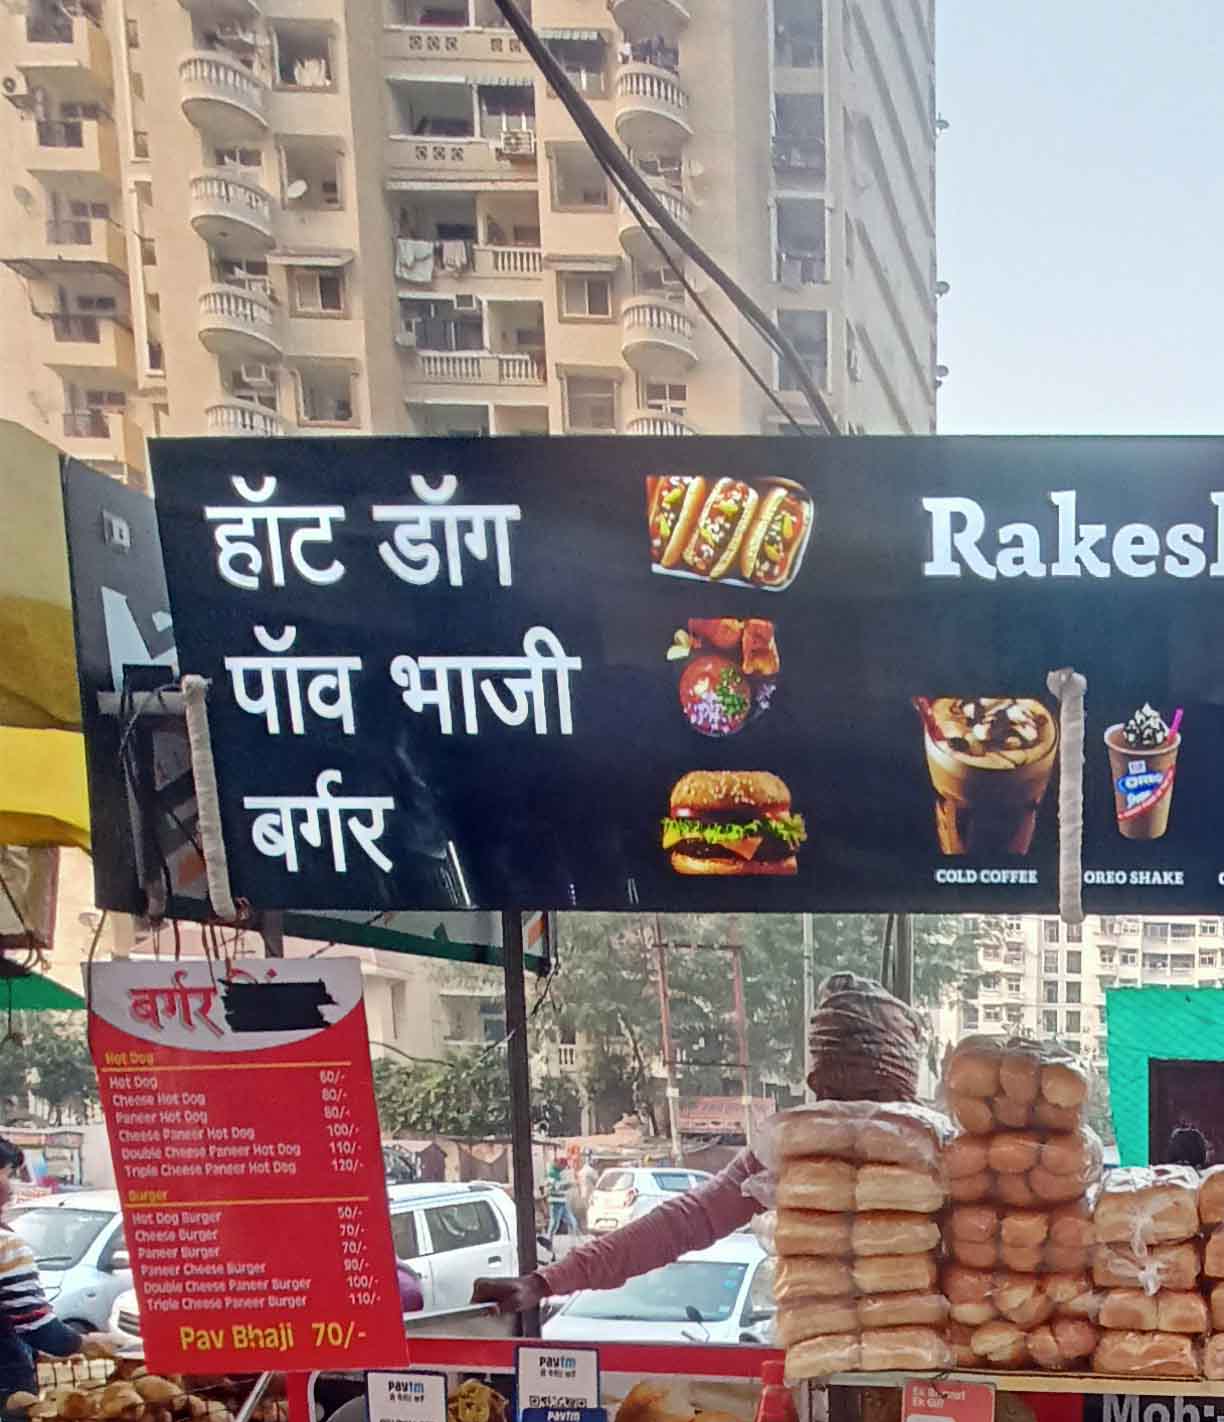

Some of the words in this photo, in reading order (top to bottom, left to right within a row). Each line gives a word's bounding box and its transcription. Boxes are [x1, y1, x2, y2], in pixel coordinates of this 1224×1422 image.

[204, 475, 346, 592] हॉट
[370, 474, 521, 587] डॉग
[225, 625, 363, 736] पॉव
[389, 625, 582, 736] भाजी
[243, 769, 396, 873] बर्गर
[935, 869, 978, 884] COLD
[980, 870, 1039, 885] COFFEE
[1083, 870, 1127, 885] OREO
[1130, 871, 1185, 886] SHAKE
[128, 969, 225, 1038] बर्गर
[110, 1077, 131, 1089] Hot
[134, 1076, 158, 1090] Dog
[112, 1094, 155, 1106] Cheese
[157, 1093, 179, 1105] Hot
[182, 1093, 206, 1107] Dog
[160, 1111, 181, 1123] Hot
[184, 1110, 208, 1124] Dog
[207, 1127, 229, 1139] Hot
[231, 1127, 255, 1140] Dog
[253, 1143, 275, 1156] Hot
[277, 1143, 301, 1157] Dog
[248, 1161, 271, 1174] Hot
[272, 1160, 297, 1175] Dog
[179, 1325, 225, 1351] Pav
[231, 1322, 295, 1352] Bhaji
[311, 1321, 367, 1350] 70/-
